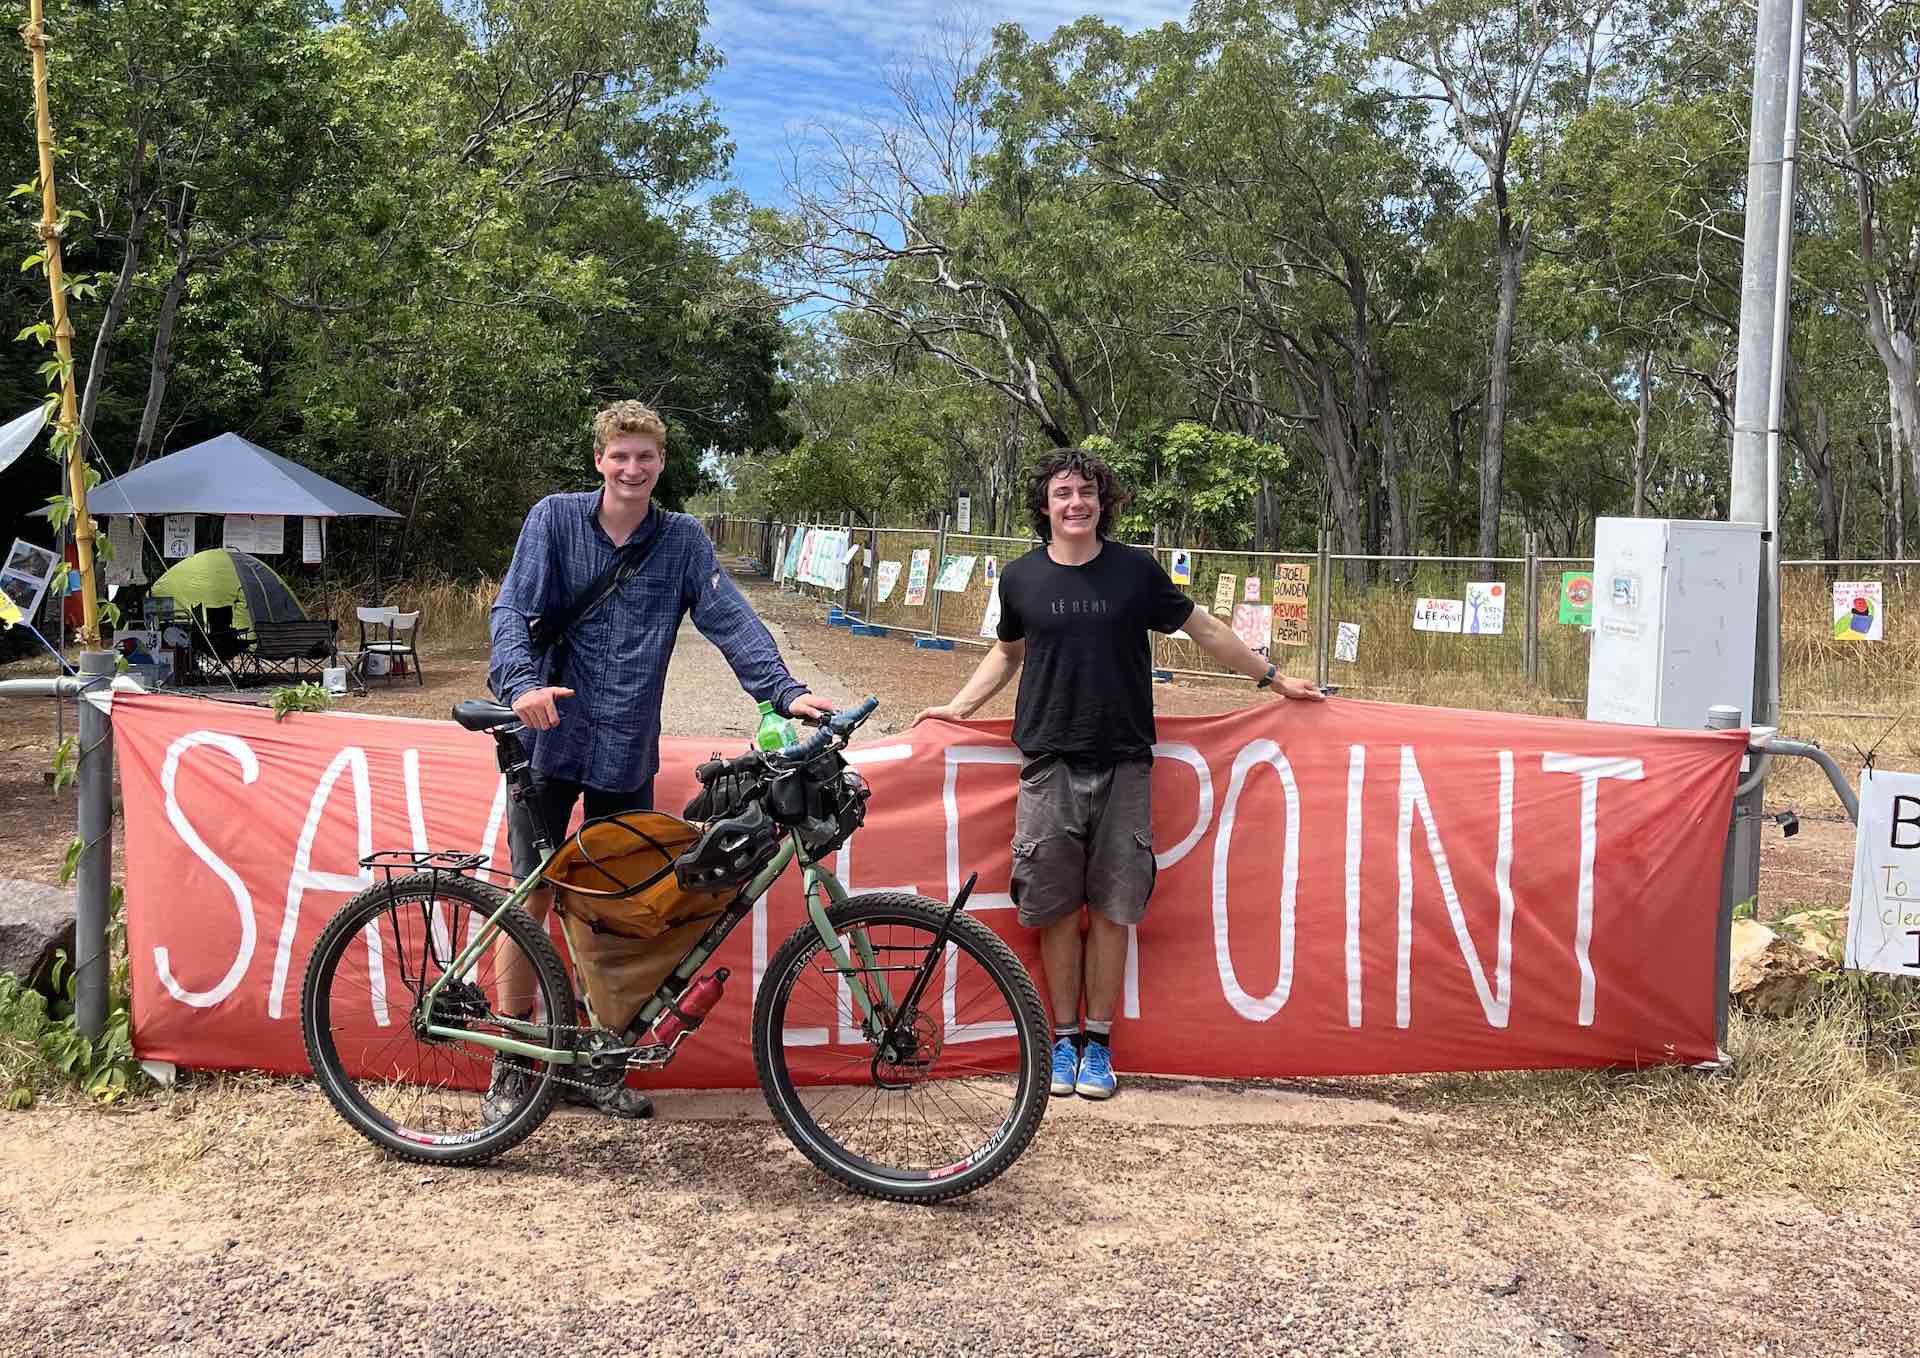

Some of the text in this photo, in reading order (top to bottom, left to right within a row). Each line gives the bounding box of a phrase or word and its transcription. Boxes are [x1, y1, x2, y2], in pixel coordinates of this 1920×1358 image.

[1282, 567, 1305, 581] JOEL
[1274, 583, 1309, 598] BOWDEN
[1273, 603, 1307, 619] REVOKE
[1416, 610, 1438, 620] LEE
[1285, 618, 1297, 629] THE
[1278, 628, 1308, 643] PERMIT
[153, 730, 555, 1028] SAV
